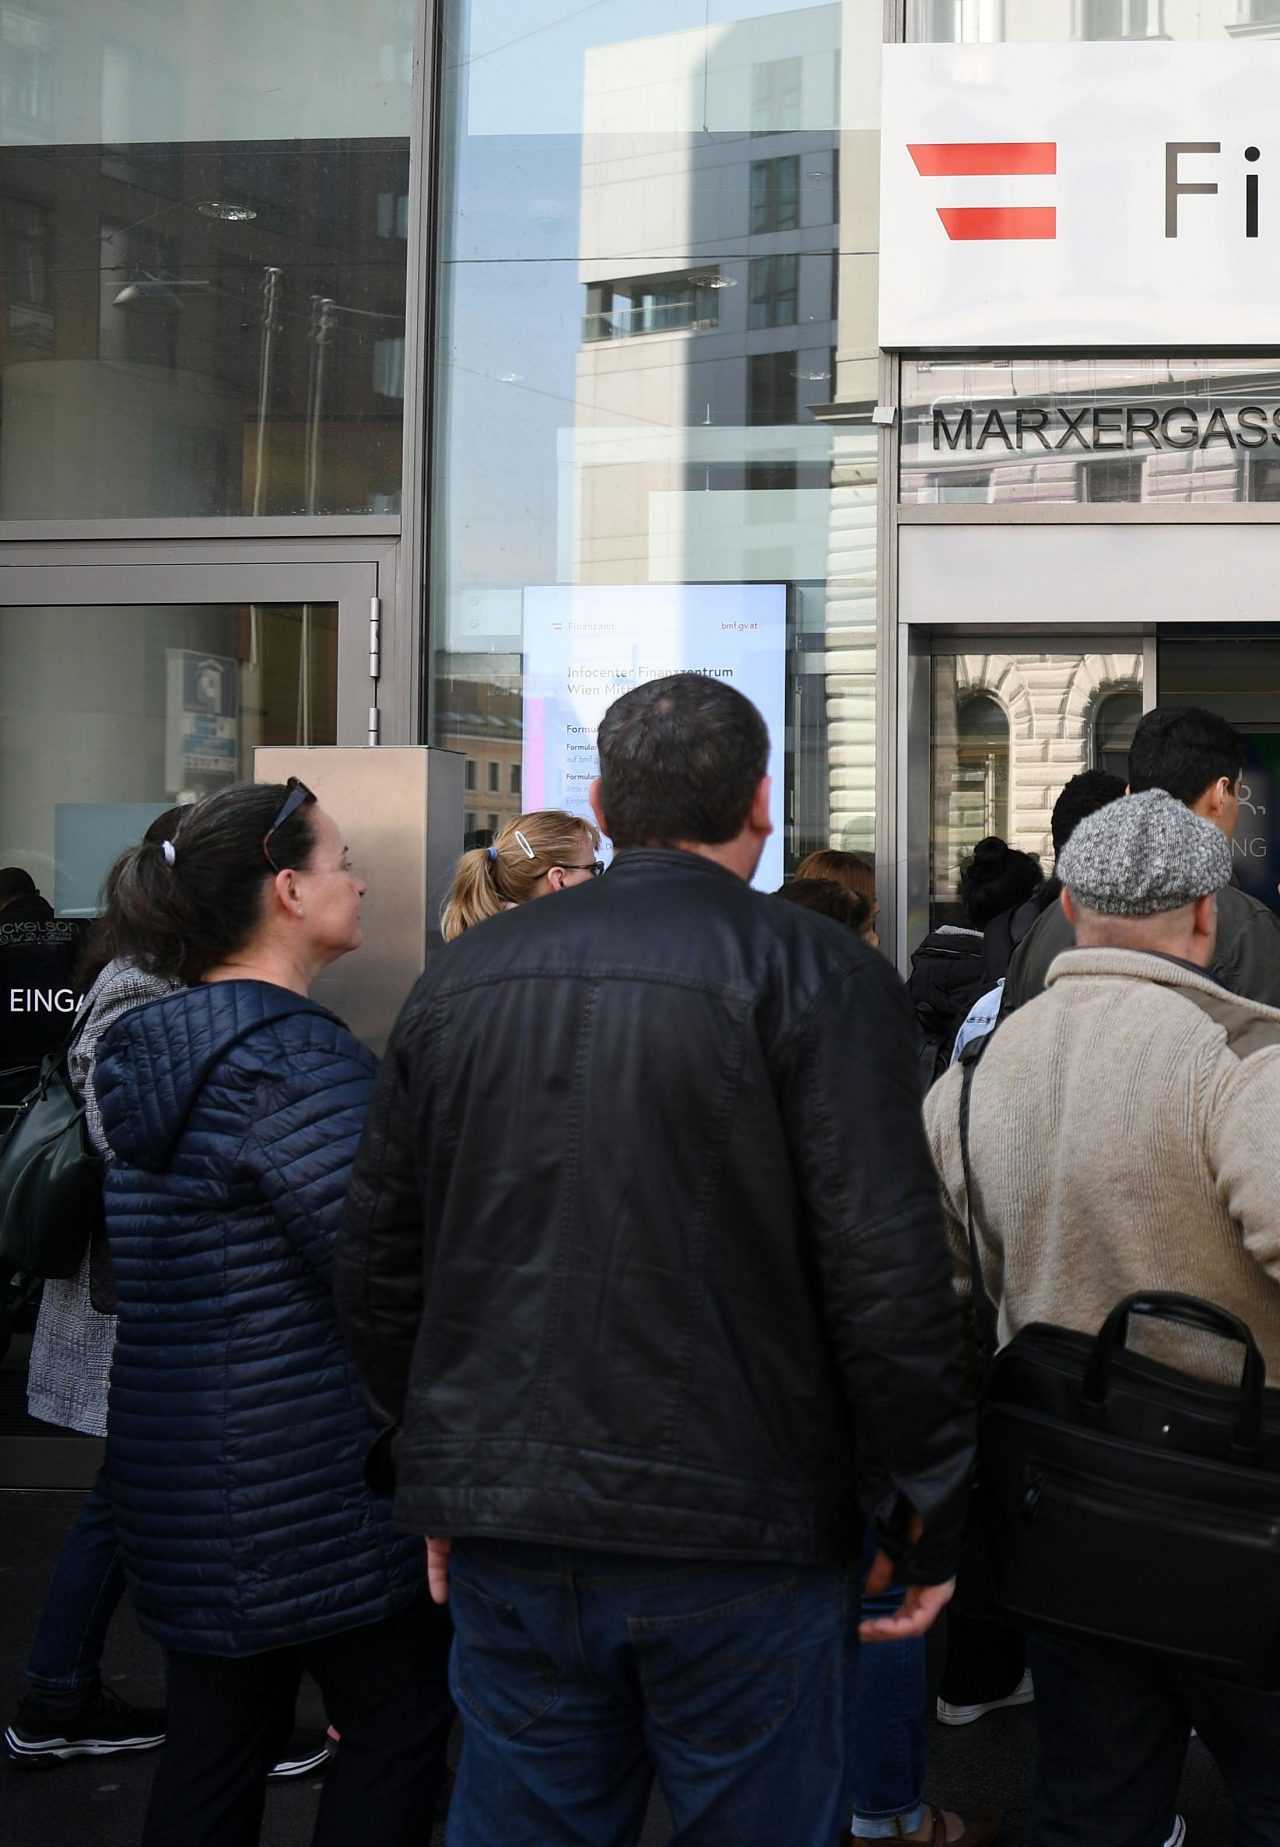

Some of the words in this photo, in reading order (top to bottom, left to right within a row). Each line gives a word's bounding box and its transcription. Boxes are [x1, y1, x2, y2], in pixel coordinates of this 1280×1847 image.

[568, 622, 615, 631] Finanzamt
[721, 621, 758, 631] bmf.gv.at
[568, 666, 634, 678] Infocenter
[567, 684, 600, 695] Wien
[605, 684, 634, 695] Mitt
[10, 988, 84, 1012] EING
